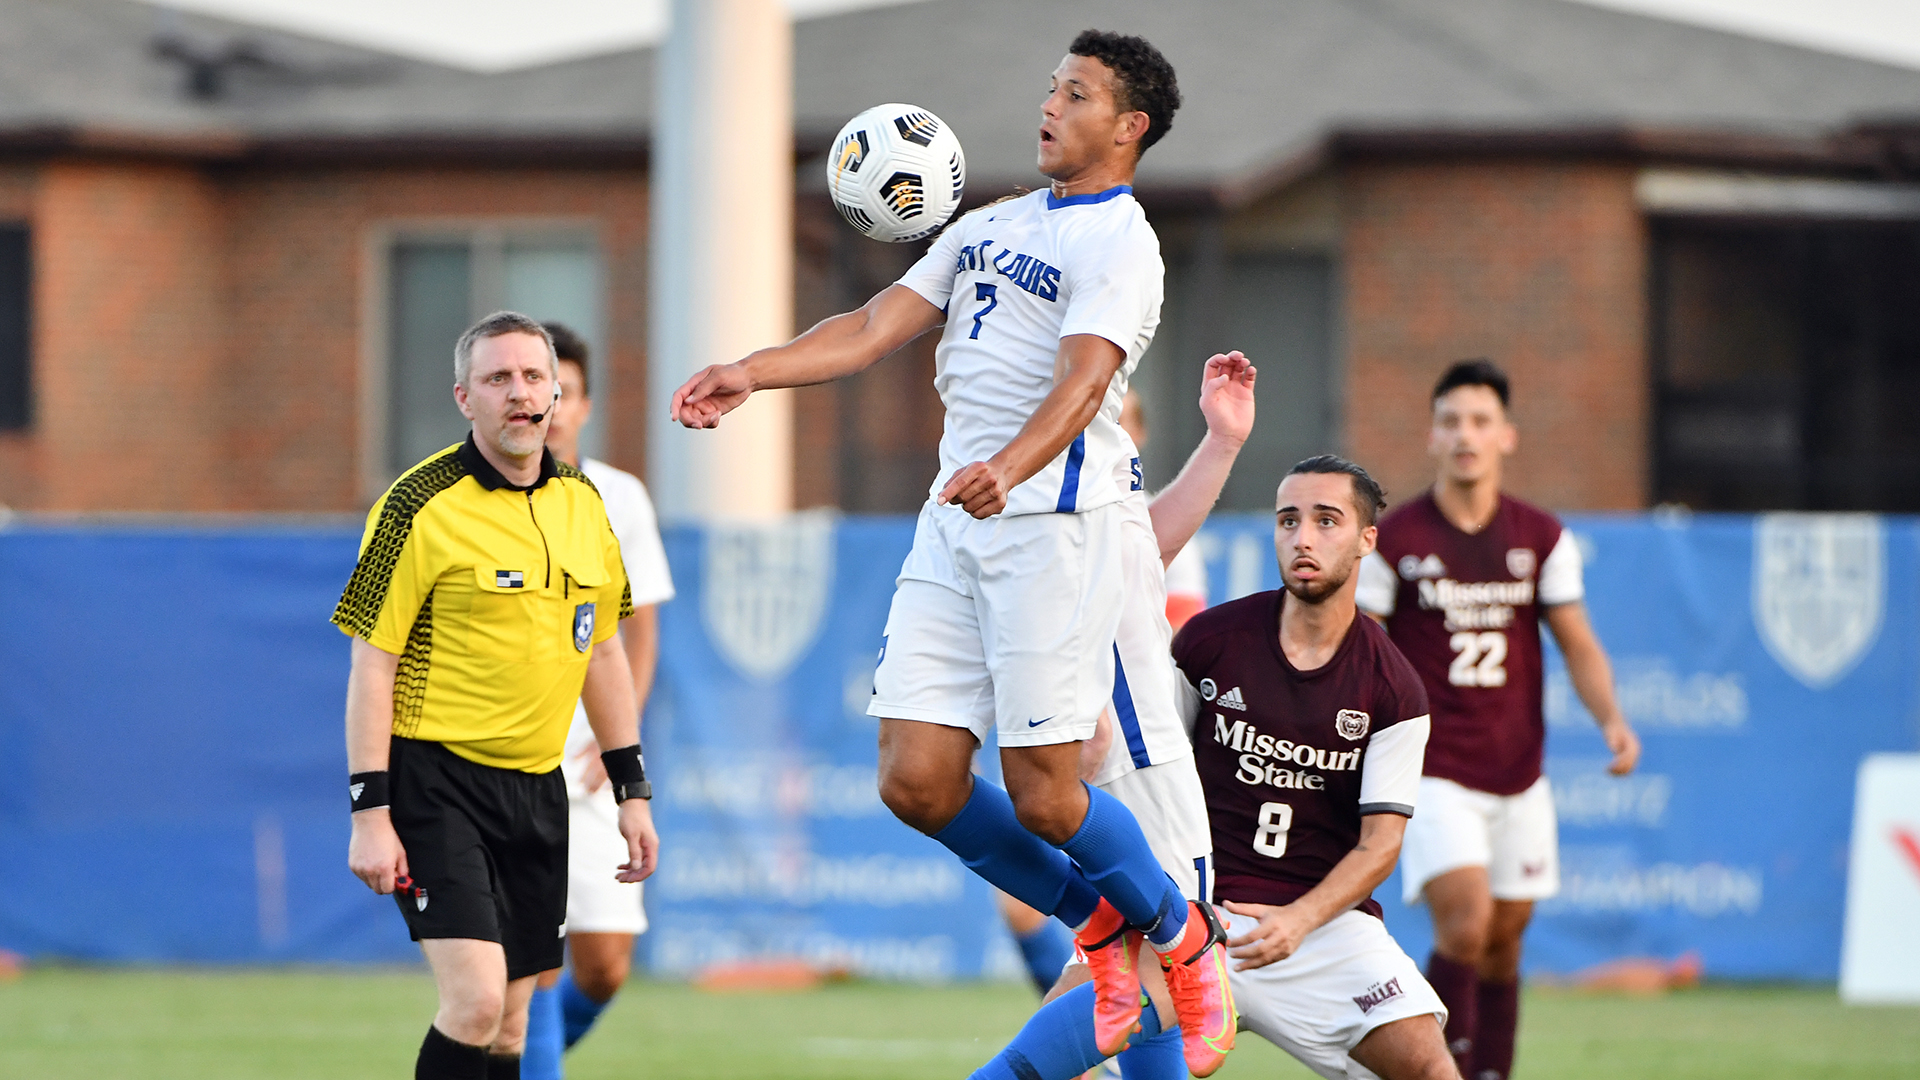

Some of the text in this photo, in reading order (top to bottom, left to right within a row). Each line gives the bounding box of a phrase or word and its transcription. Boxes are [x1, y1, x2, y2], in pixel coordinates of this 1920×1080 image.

[993, 248, 1061, 303] LOUIS
[968, 282, 998, 340] 7
[1130, 457, 1144, 491] S
[1448, 631, 1508, 687] 22
[1216, 698, 1247, 711] adidas
[1213, 713, 1361, 771] Missouri
[1235, 754, 1325, 791] State
[1253, 801, 1293, 859] 8
[1192, 855, 1213, 902] 1
